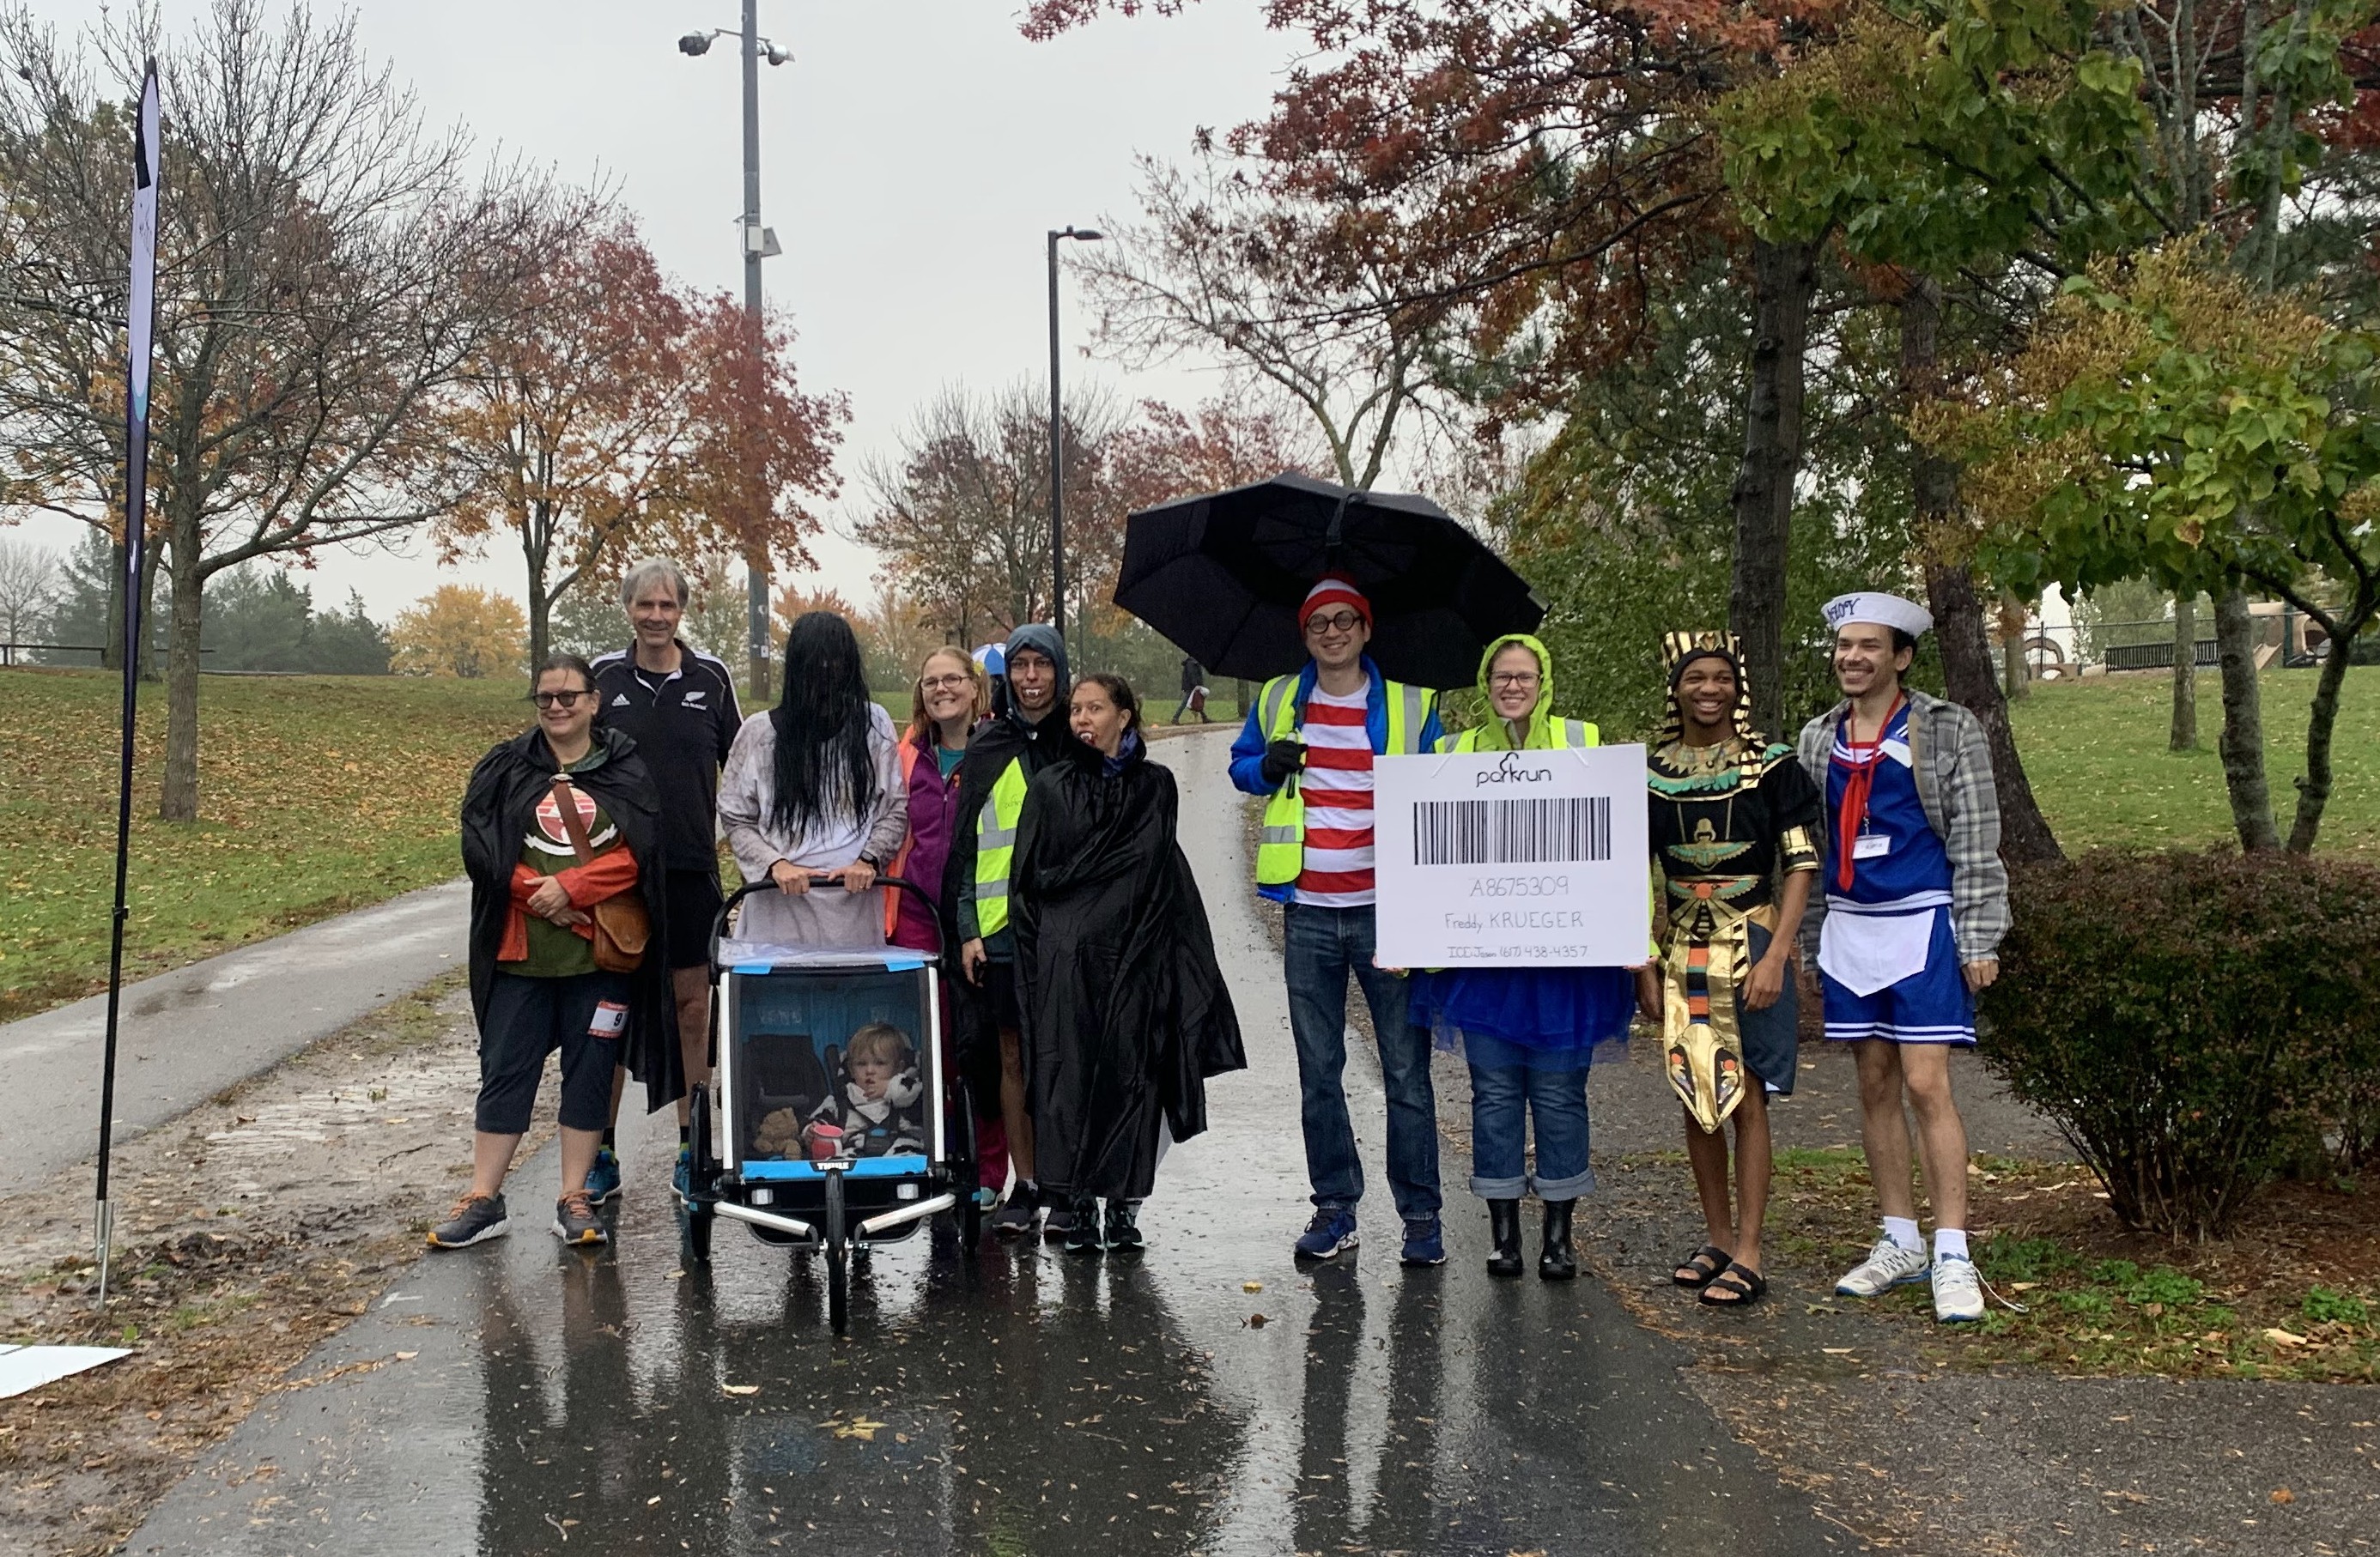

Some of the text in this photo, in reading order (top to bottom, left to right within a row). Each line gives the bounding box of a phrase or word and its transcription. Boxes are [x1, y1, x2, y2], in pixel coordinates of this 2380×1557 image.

[1476, 752, 1551, 788] parkrun
[1470, 875, 1569, 897] A8675309
[1445, 912, 1583, 933] Freddy KRUEGER
[1525, 945, 1588, 958] 438-4357
[613, 1012, 622, 1027] 9
